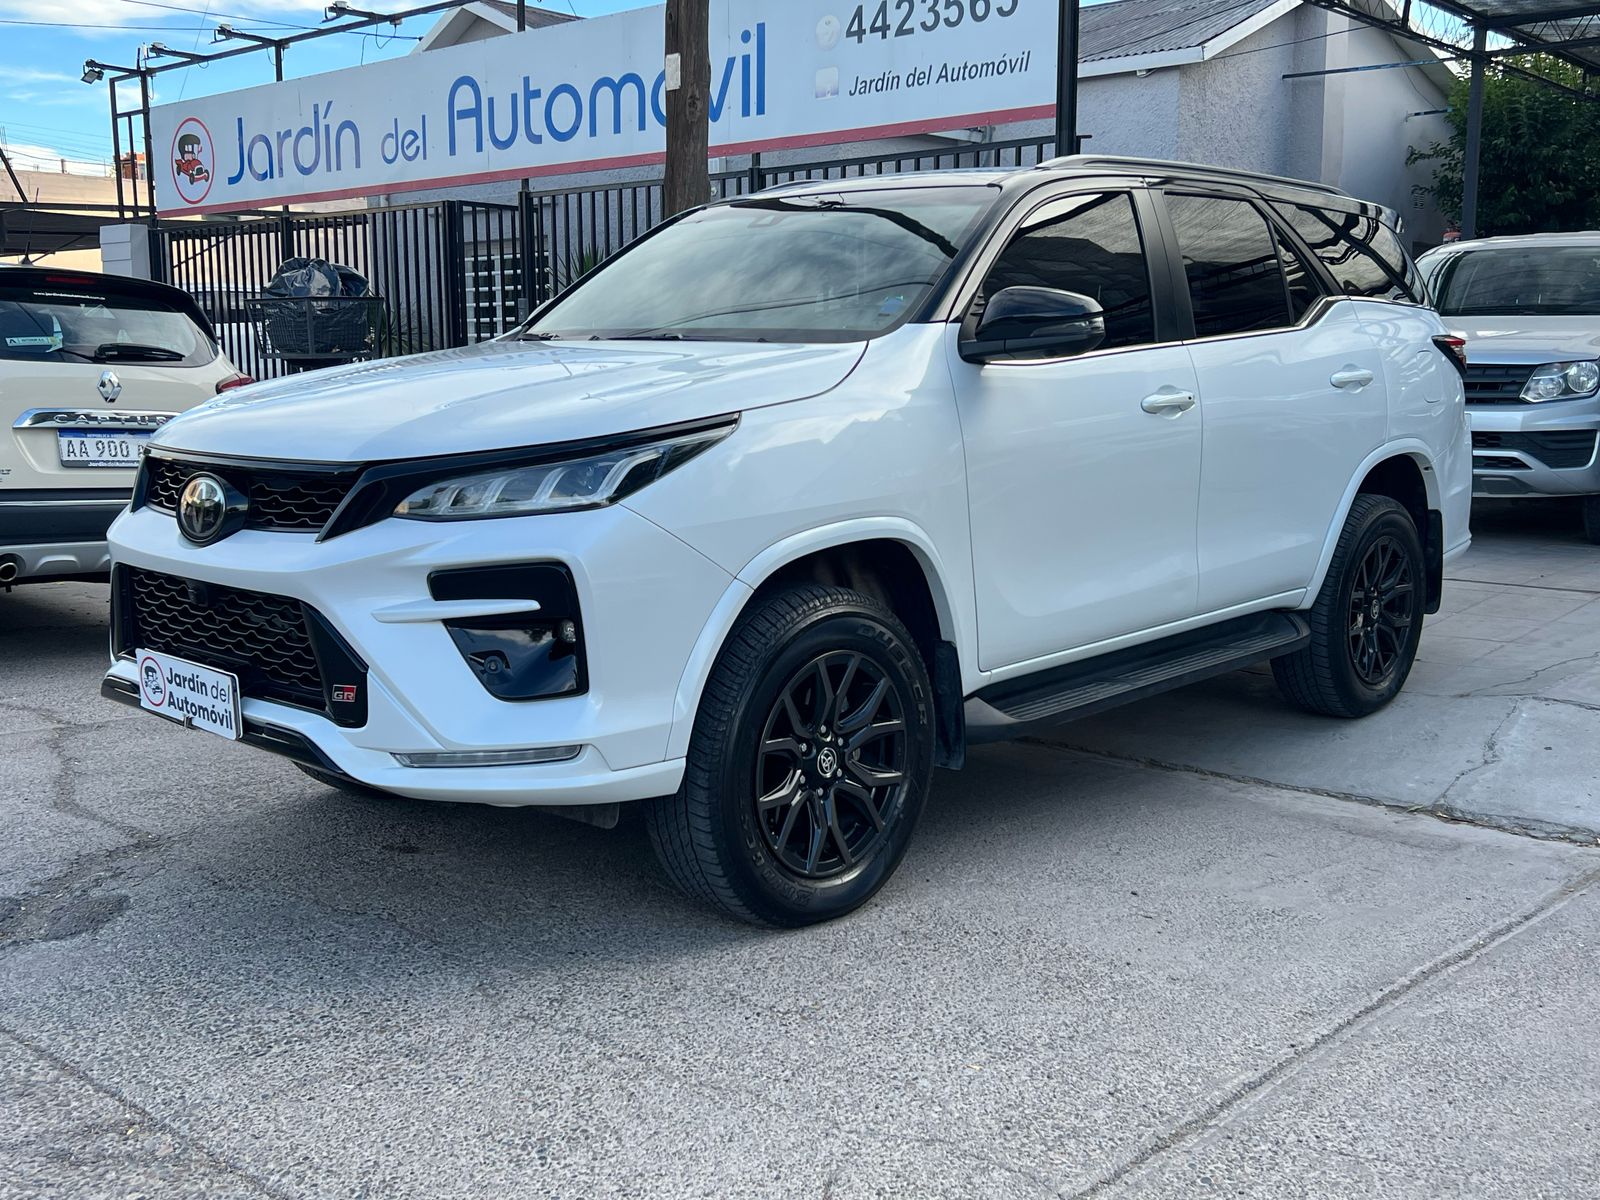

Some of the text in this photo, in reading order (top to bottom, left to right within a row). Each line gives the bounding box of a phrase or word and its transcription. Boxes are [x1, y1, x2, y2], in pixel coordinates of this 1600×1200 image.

[849, 50, 1031, 96] Jardín del Automóvil
[227, 100, 361, 185] Jardín
[381, 114, 427, 165] del
[67, 440, 89, 457] AA
[96, 440, 130, 457] 900
[166, 667, 230, 704] Jardín del
[333, 691, 354, 702] GR
[167, 692, 233, 730] Automóvil
